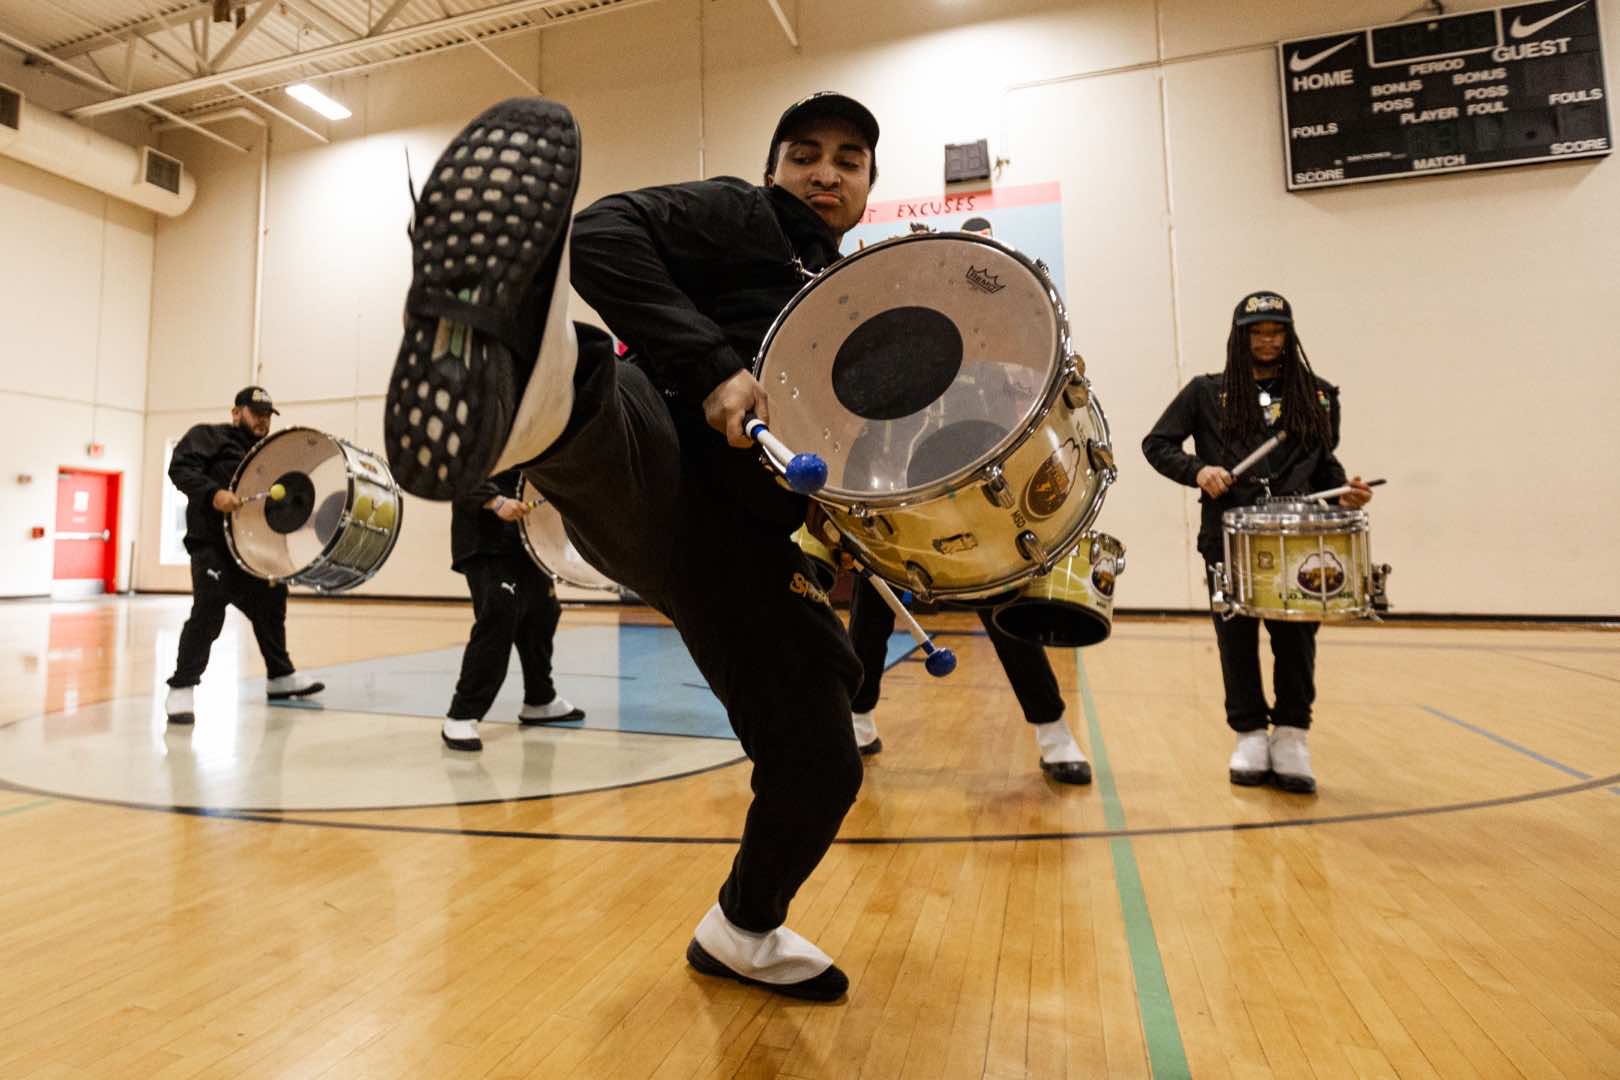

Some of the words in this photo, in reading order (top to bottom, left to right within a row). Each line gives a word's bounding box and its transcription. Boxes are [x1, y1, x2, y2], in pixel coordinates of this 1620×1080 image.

[1493, 38, 1572, 62] GUEST
[1409, 58, 1465, 76] PERIOD
[1292, 69, 1354, 92] HOME
[1453, 68, 1507, 85] BONUS
[1371, 79, 1423, 97] BONUS
[1464, 85, 1509, 101] POSS
[1549, 88, 1603, 106] FOULS
[1372, 97, 1415, 113] POSS
[1400, 106, 1459, 125] PLAYER
[1467, 101, 1508, 117] FOUL
[1291, 122, 1338, 140] FOULS
[1551, 138, 1607, 155] SCORE
[1413, 154, 1466, 170] MATCH
[1295, 168, 1344, 184] SCORE
[897, 196, 976, 218] EXCUSES
